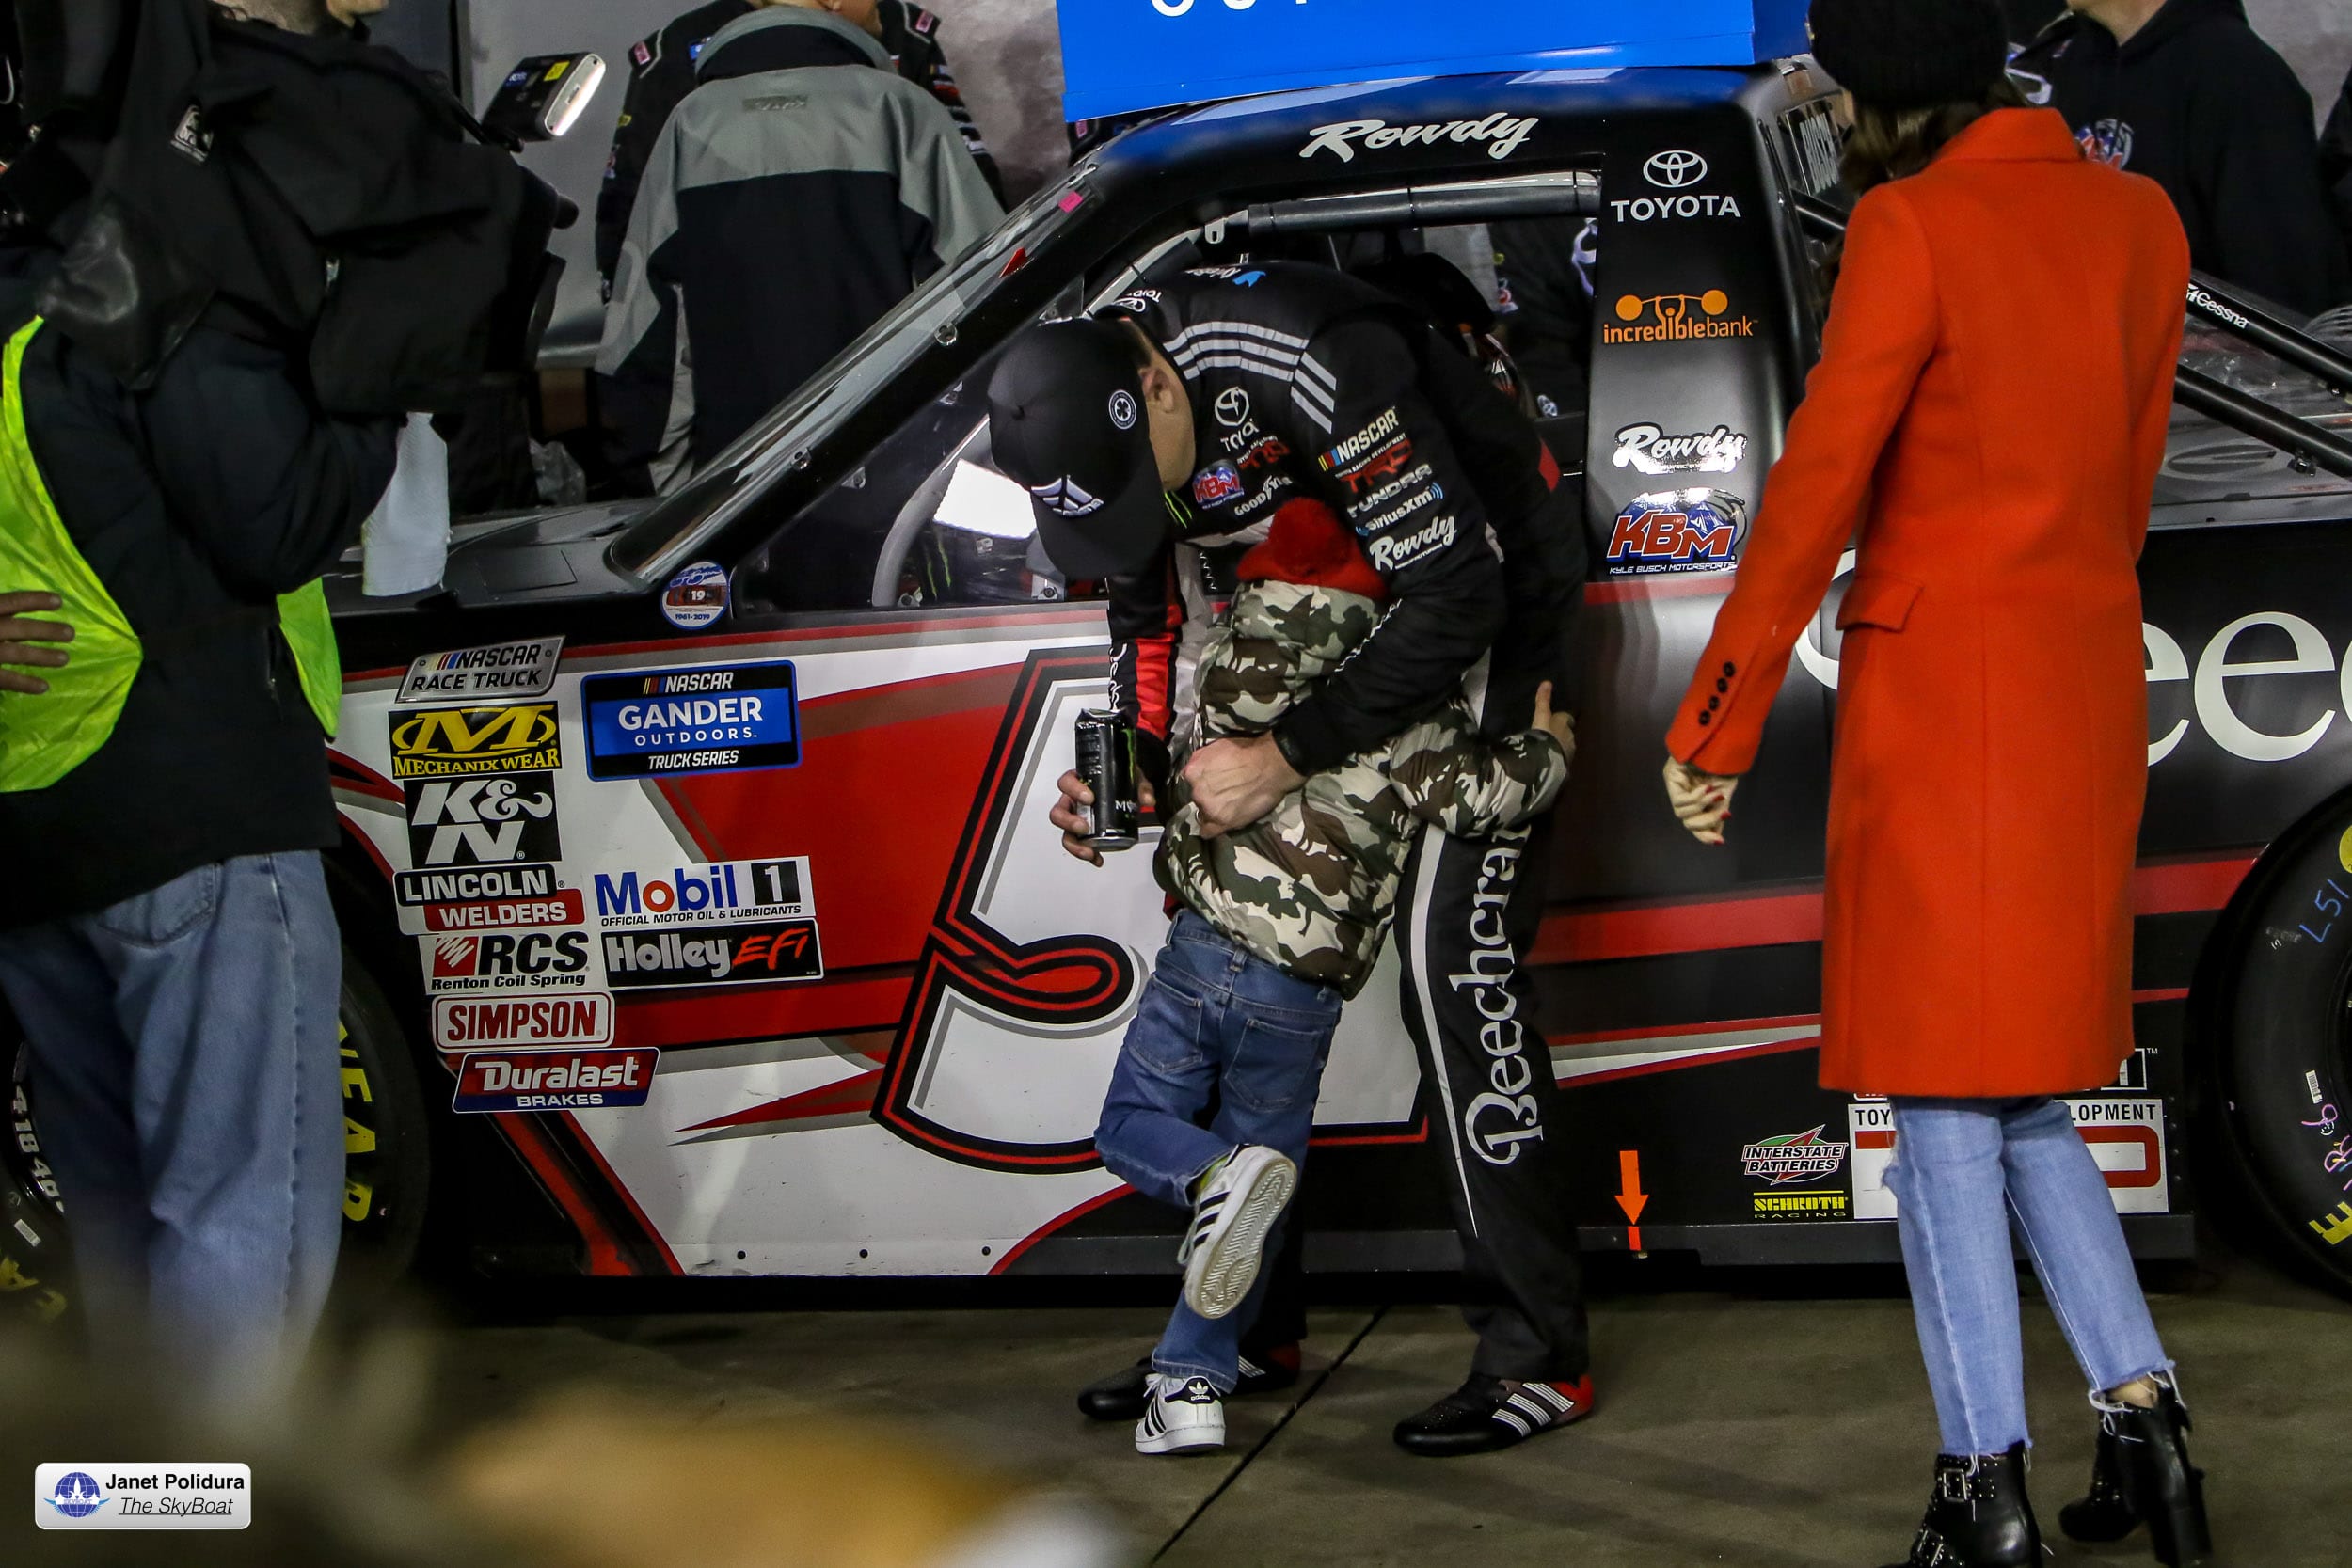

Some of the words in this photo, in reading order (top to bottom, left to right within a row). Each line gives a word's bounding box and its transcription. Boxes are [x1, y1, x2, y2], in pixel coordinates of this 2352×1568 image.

[1299, 112, 1539, 164] Rowdy
[1611, 195, 1741, 222] TOYOTA
[2196, 292, 2249, 329] Cessna
[1603, 315, 1754, 345] incrediblebank
[1336, 408, 1400, 463] NASCAR
[1613, 424, 1746, 474] Rowdy
[1346, 464, 1433, 518] TUNDRA
[1369, 515, 1457, 571] Rowdy
[1607, 509, 1735, 560] KBM
[1610, 565, 1633, 575] KYLE
[1636, 564, 1667, 573] BUSCH
[1668, 561, 1738, 572] MOTORSPORTS
[691, 590, 706, 601] 19
[455, 643, 542, 670] NASCAR
[411, 673, 467, 690] RACE
[473, 669, 542, 688] TRUCK
[665, 672, 734, 693] NASCAR
[618, 696, 763, 731] GANDER
[634, 727, 753, 746] OUTDOORS
[393, 755, 499, 777] MECHANIX
[501, 748, 561, 770] WEAR
[648, 753, 692, 770] TRUCK
[692, 750, 739, 767] SERIES
[404, 870, 548, 902] LINCOLN
[594, 864, 738, 916] Mobil
[764, 865, 784, 902] 1
[439, 901, 567, 927] WELDERS
[601, 915, 649, 927] OFFICIAL
[654, 912, 693, 924] MOTOR
[697, 911, 715, 921] OIL
[719, 910, 726, 919] &
[730, 906, 802, 919] LUBRICANTS
[478, 931, 589, 976] RCS
[605, 933, 731, 978] Holley
[432, 977, 489, 990] Renton
[494, 975, 526, 988] Coil
[530, 974, 586, 988] Spring
[447, 1000, 596, 1041] SIMPSON
[475, 1056, 639, 1092] Duralast
[517, 1094, 604, 1107] BRAKES
[1744, 1146, 1843, 1159] INTERSTATE
[1748, 1159, 1836, 1173] BATTERIES
[1754, 1196, 1845, 1212] SCHROTH
